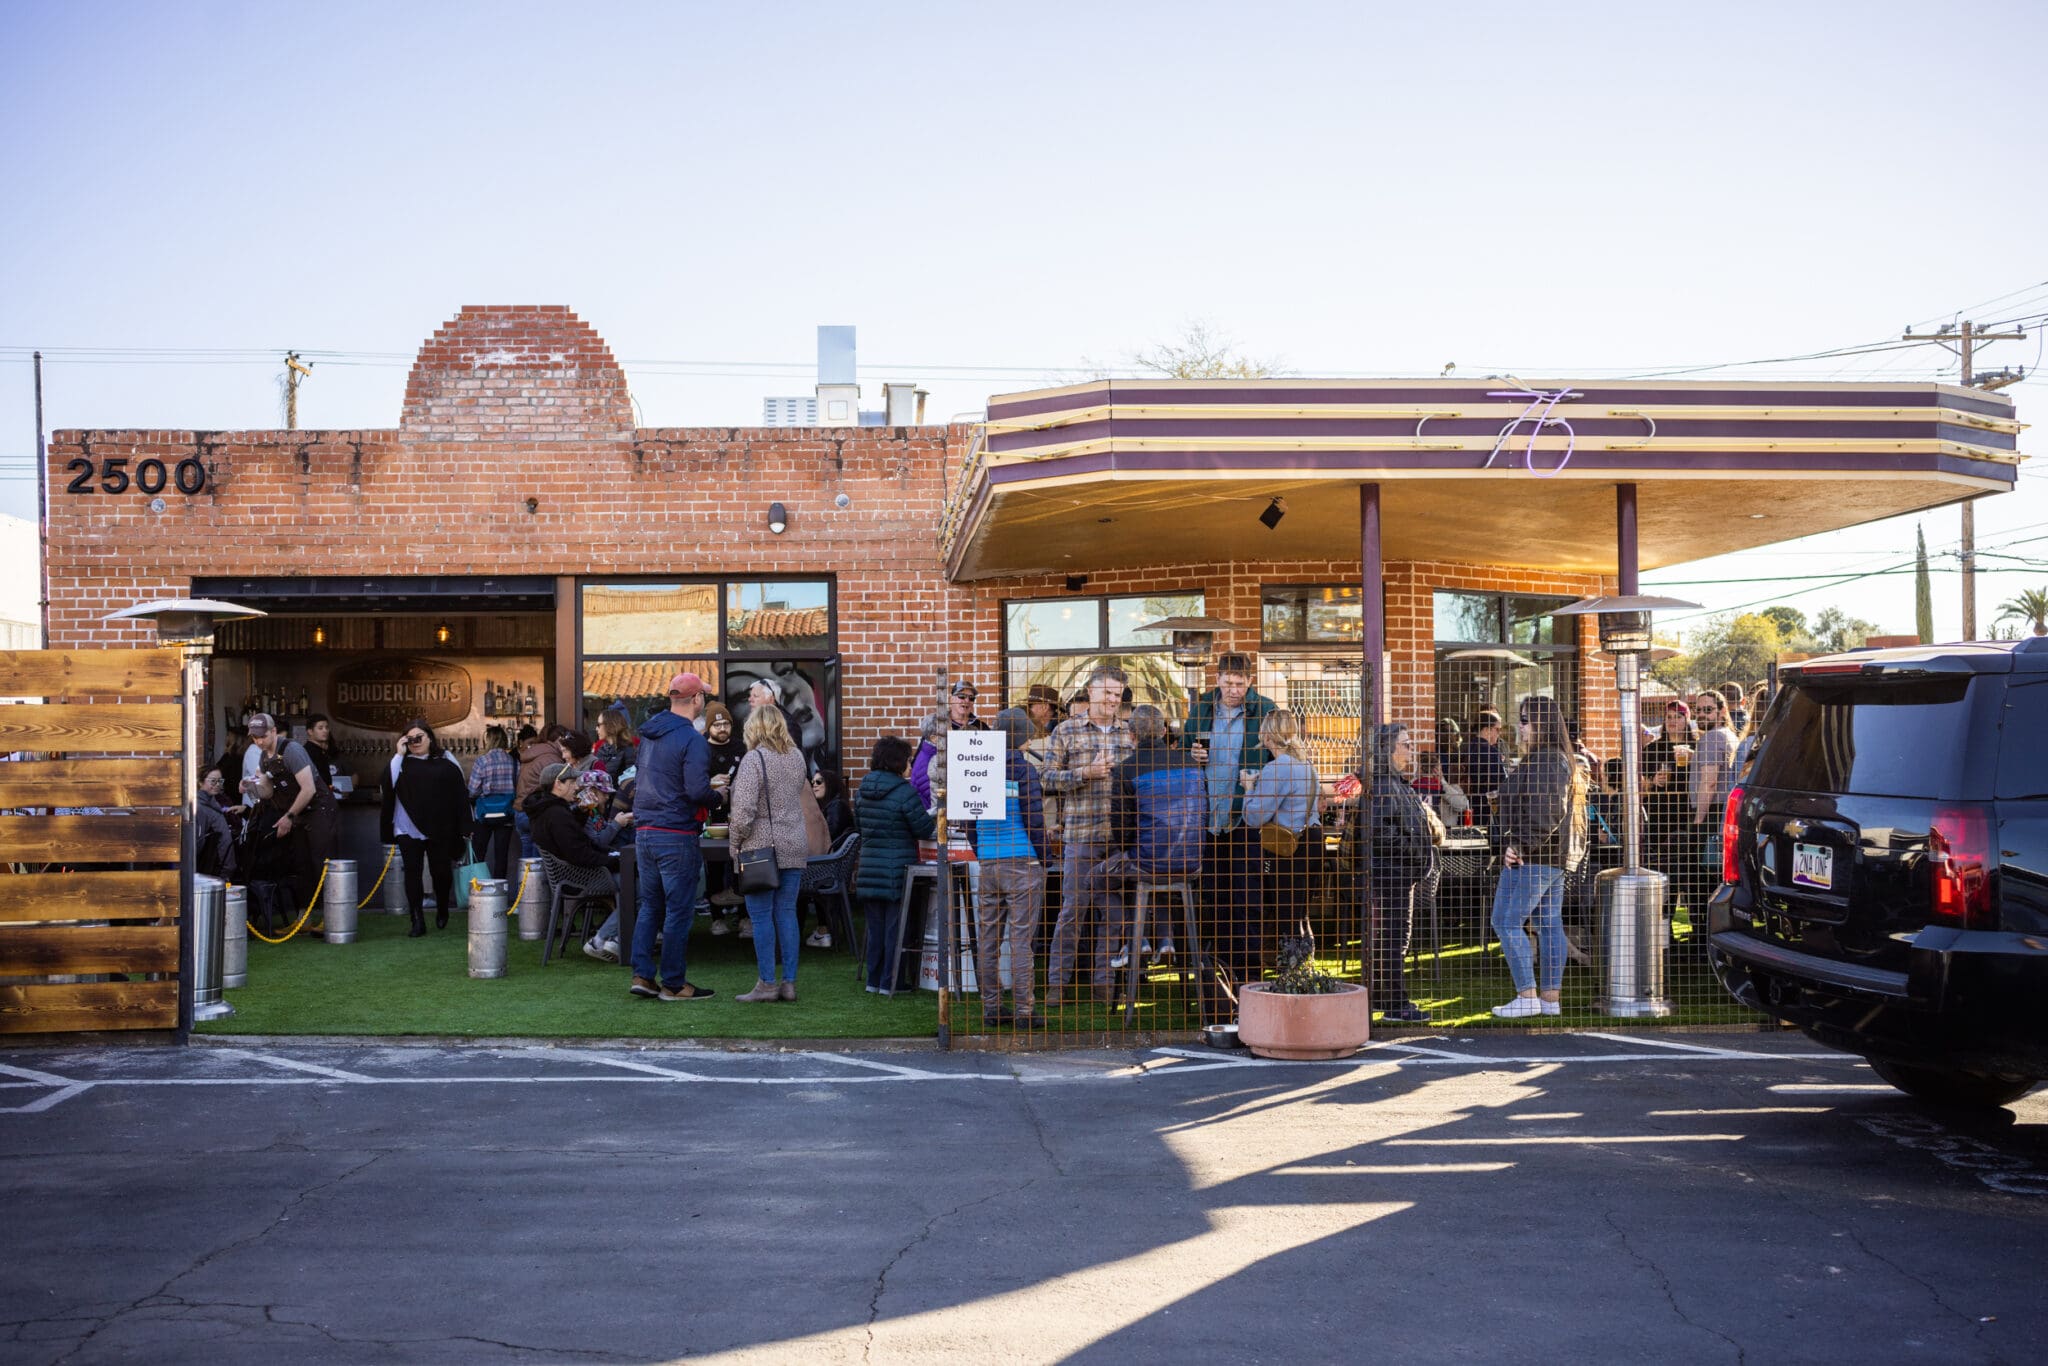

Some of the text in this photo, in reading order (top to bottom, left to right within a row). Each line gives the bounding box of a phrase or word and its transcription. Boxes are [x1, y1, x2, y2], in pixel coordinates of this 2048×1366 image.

[67, 458, 205, 494] 2500
[337, 680, 462, 704] BORDERLANDS
[969, 738, 983, 746] No
[957, 753, 995, 762] Outside
[964, 769, 988, 777] Food
[970, 785, 982, 793] Or
[963, 801, 989, 809] Drink
